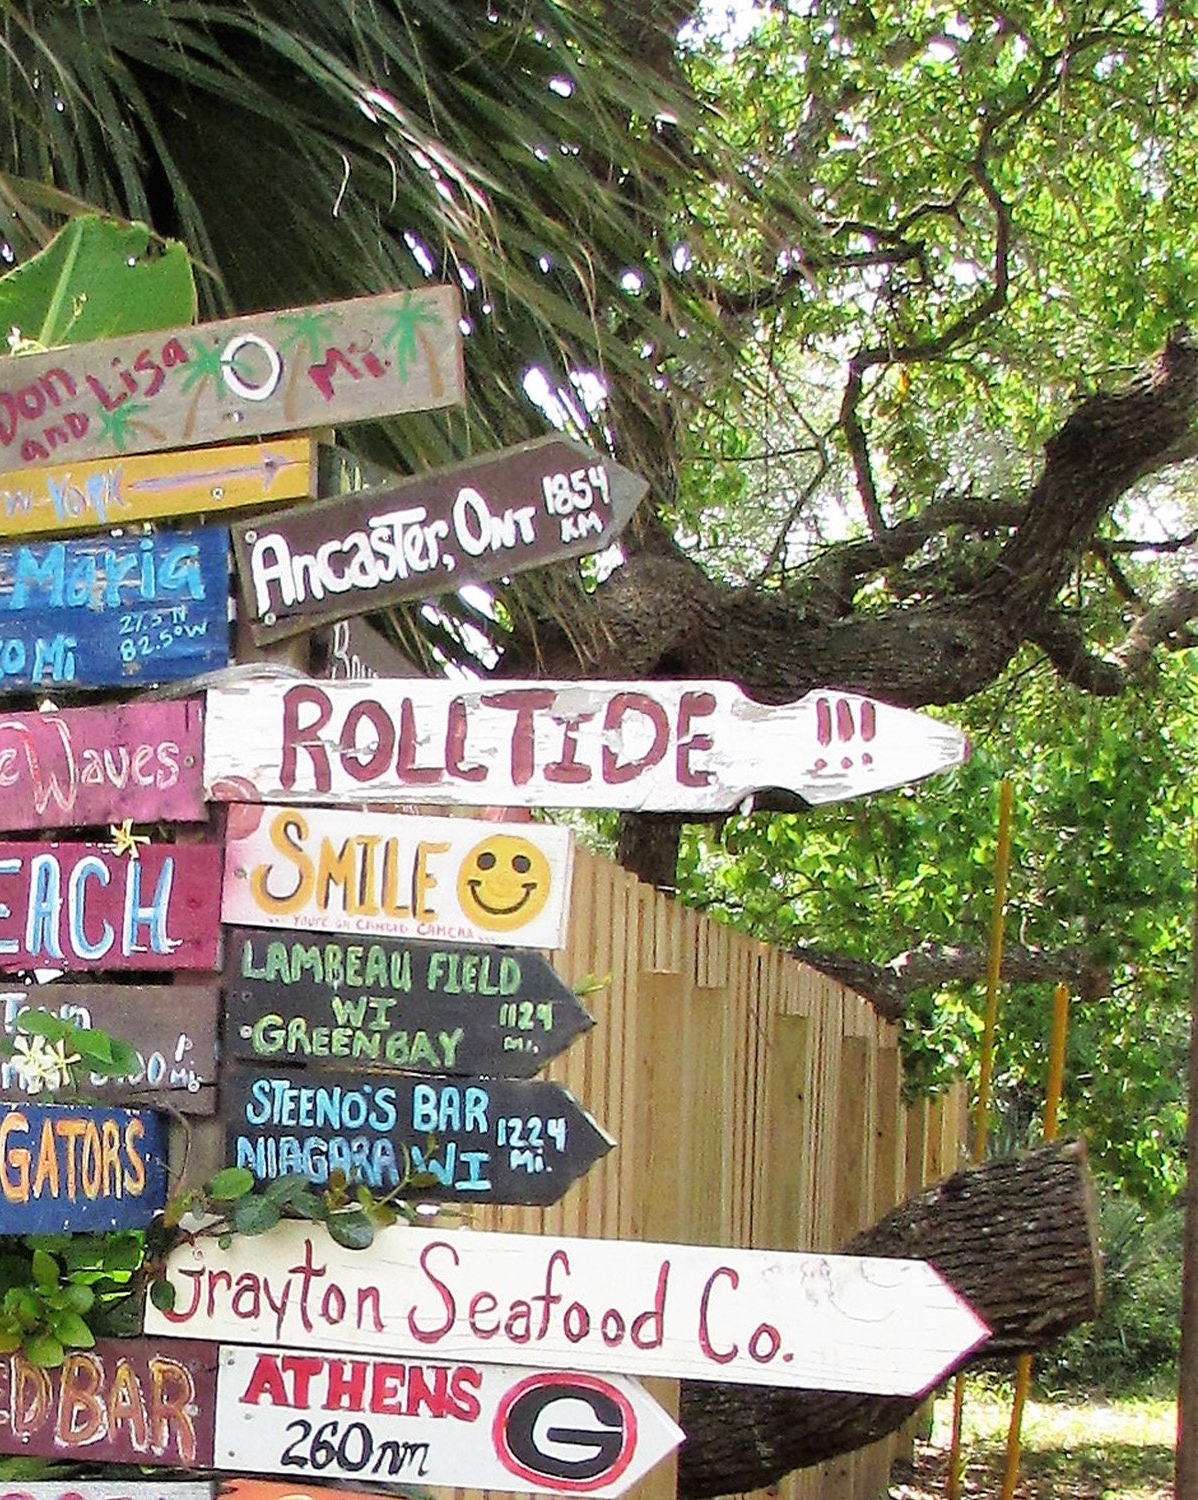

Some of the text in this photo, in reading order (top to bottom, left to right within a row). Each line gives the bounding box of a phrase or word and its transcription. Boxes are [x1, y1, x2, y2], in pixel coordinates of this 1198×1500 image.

[86, 337, 189, 410] Lisa
[542, 464, 611, 515] 1854
[560, 513, 605, 543] KM
[3, 540, 207, 611] Maria
[32, 635, 78, 684] Mi
[251, 810, 452, 923] SMILE
[242, 940, 522, 997] LAMBEAU FIELD
[332, 995, 397, 1031] WI
[412, 1084, 490, 1134] BAR
[498, 1116, 566, 1153] 1224
[236, 1135, 492, 1191] NIAGARA WI
[408, 1241, 670, 1349] Seafood
[699, 1266, 795, 1364] Co.
[239, 1353, 484, 1423] ATHENS
